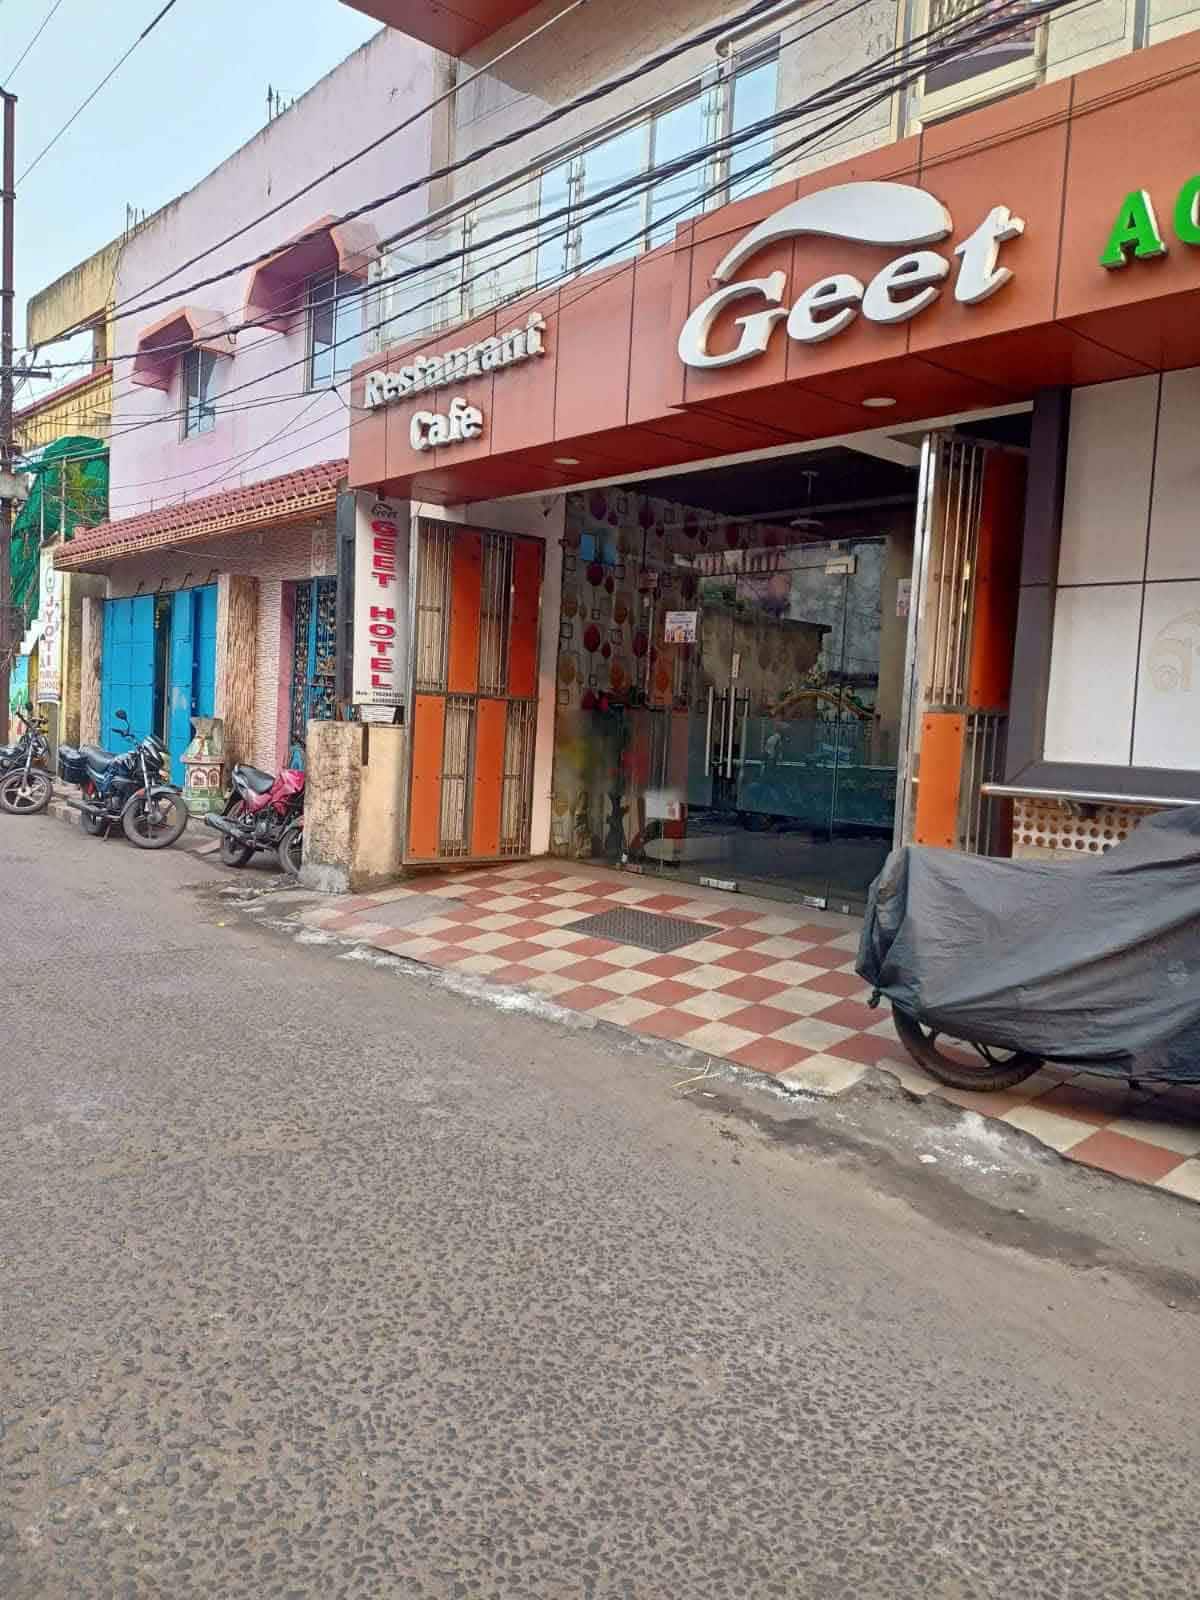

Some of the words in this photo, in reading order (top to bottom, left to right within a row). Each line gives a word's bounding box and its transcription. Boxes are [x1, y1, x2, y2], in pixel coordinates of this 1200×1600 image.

[678, 204, 1025, 368] Geet
[364, 312, 546, 409] Restaurant
[410, 397, 483, 450] Cafe
[371, 520, 397, 588] GEET
[369, 606, 396, 689] HOTEL
